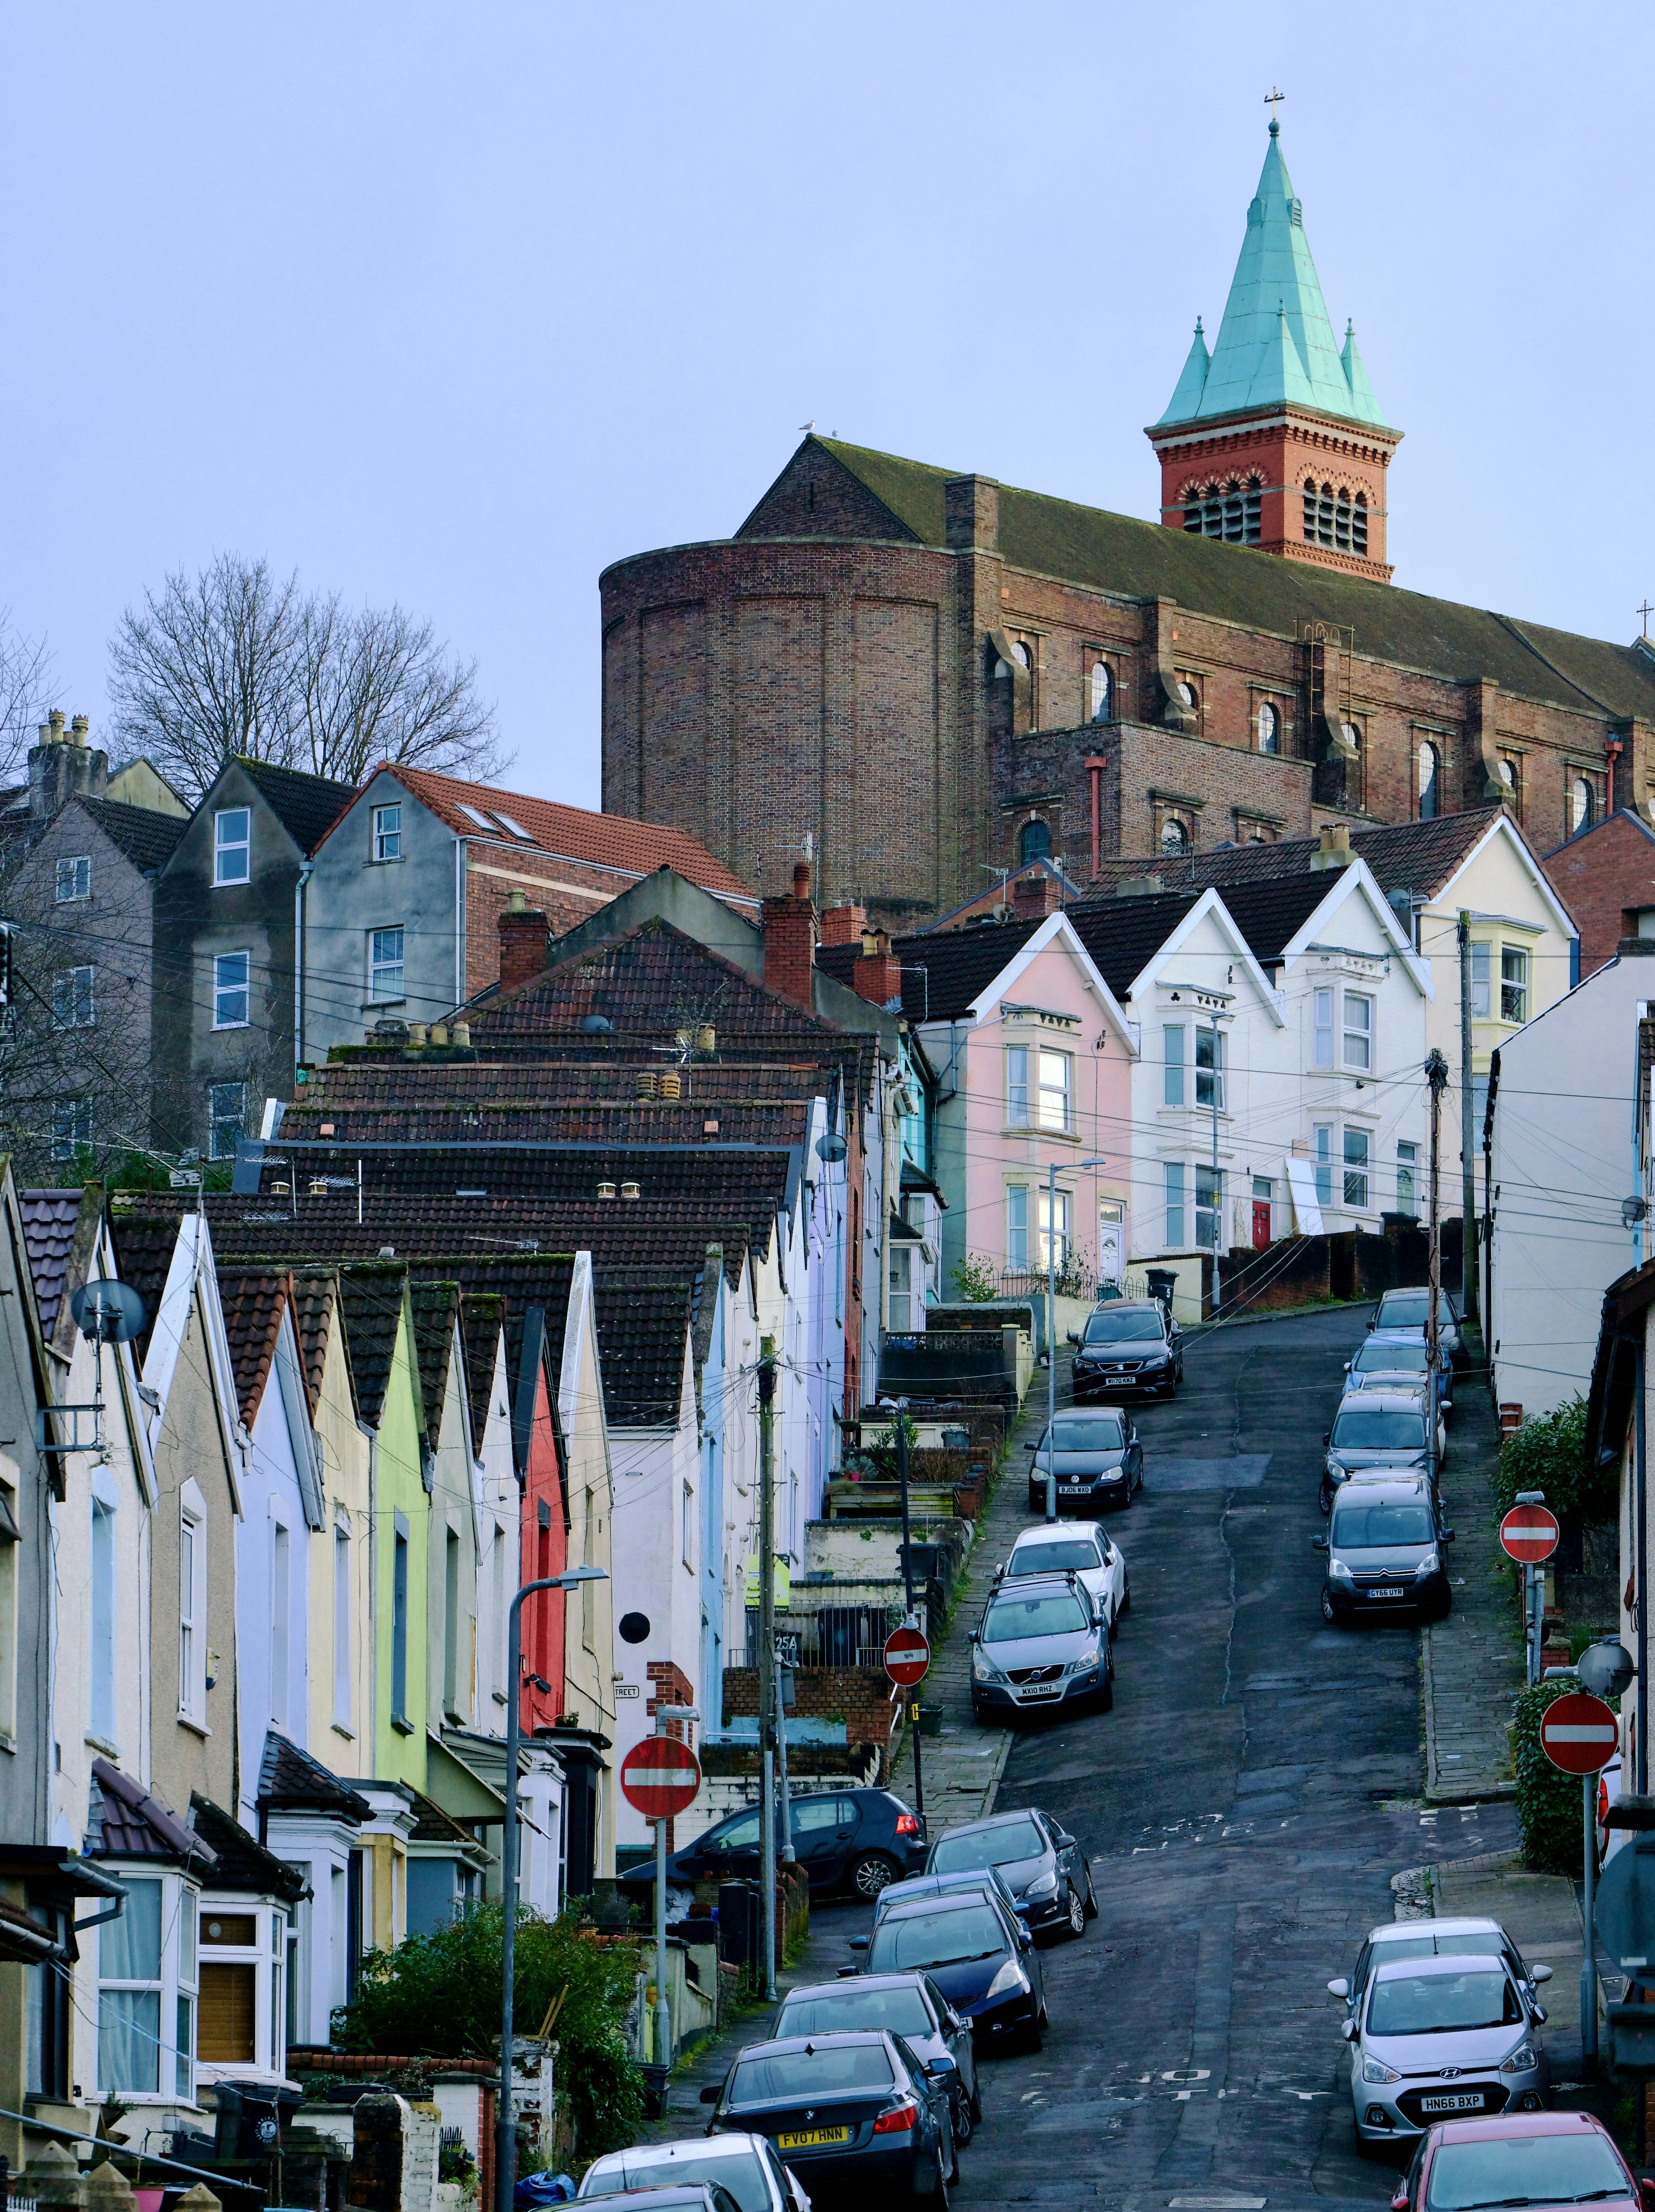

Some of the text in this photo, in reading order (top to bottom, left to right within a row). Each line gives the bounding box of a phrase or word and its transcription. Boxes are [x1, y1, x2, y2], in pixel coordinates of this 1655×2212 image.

[1166, 1288, 1170, 1298] 5
[775, 1636, 797, 1651] 25A
[1426, 2096, 1479, 2110] HN66 BXP
[783, 2127, 843, 2146] FV07 HNN
